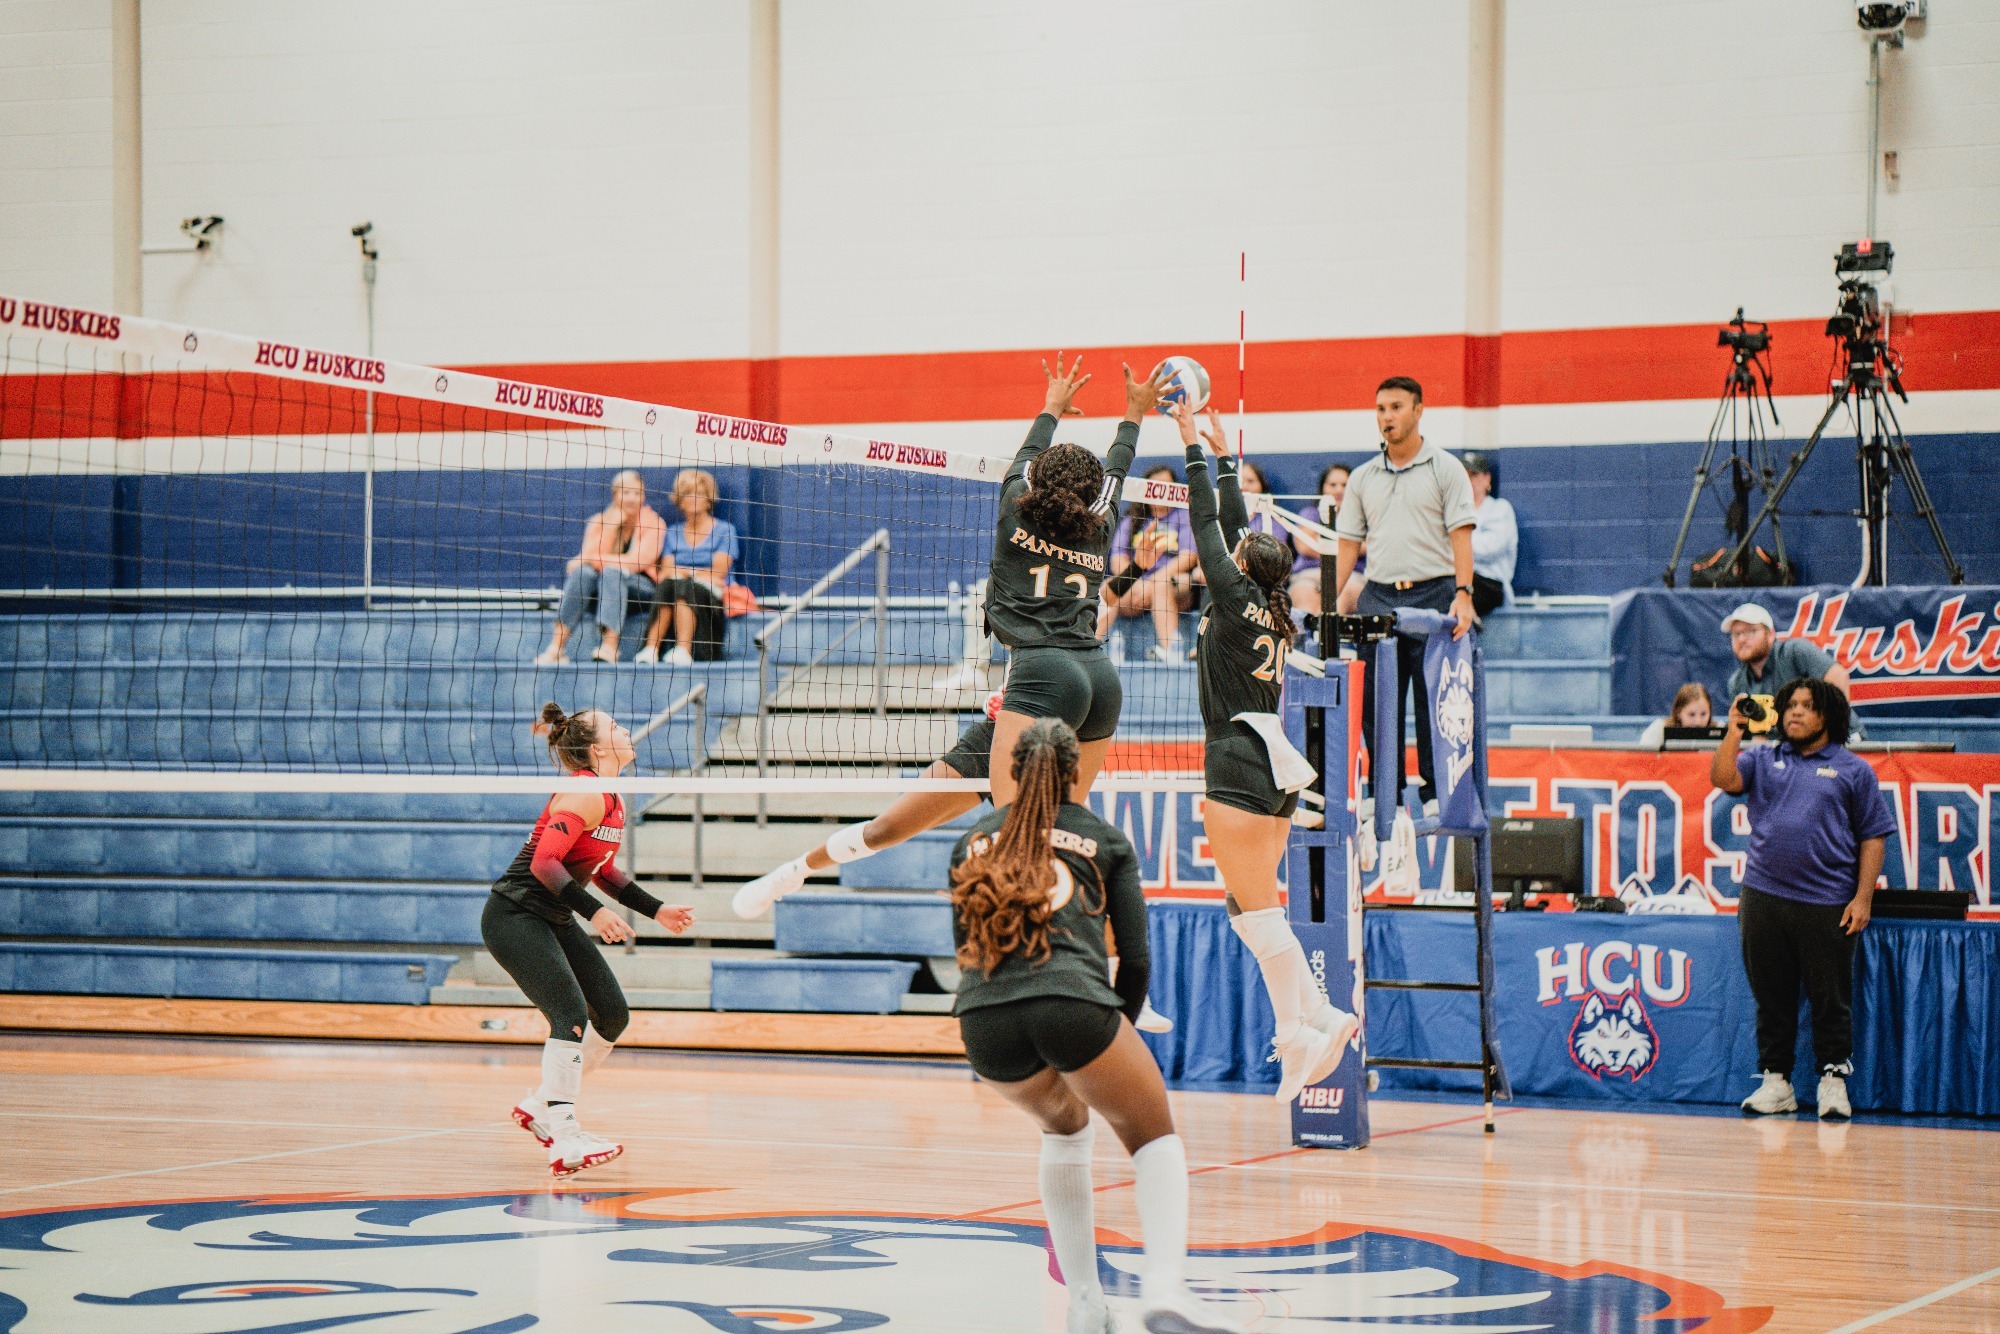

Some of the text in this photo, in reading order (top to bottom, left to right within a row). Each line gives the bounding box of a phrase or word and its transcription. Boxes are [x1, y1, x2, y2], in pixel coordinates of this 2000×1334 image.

[21, 301, 120, 340] HUSKIES
[255, 341, 385, 383] HCU HUSKIES
[495, 381, 604, 418] HCU HUSKIES
[696, 414, 788, 446] HCU HUSKIES
[866, 440, 947, 468] HCU HUSKIES
[1145, 481, 1167, 499] HCU
[1010, 527, 1104, 571] PANTHERS
[1551, 777, 1682, 898] TO
[1535, 940, 1692, 1007] HCU
[1298, 1087, 1344, 1108] HBU
